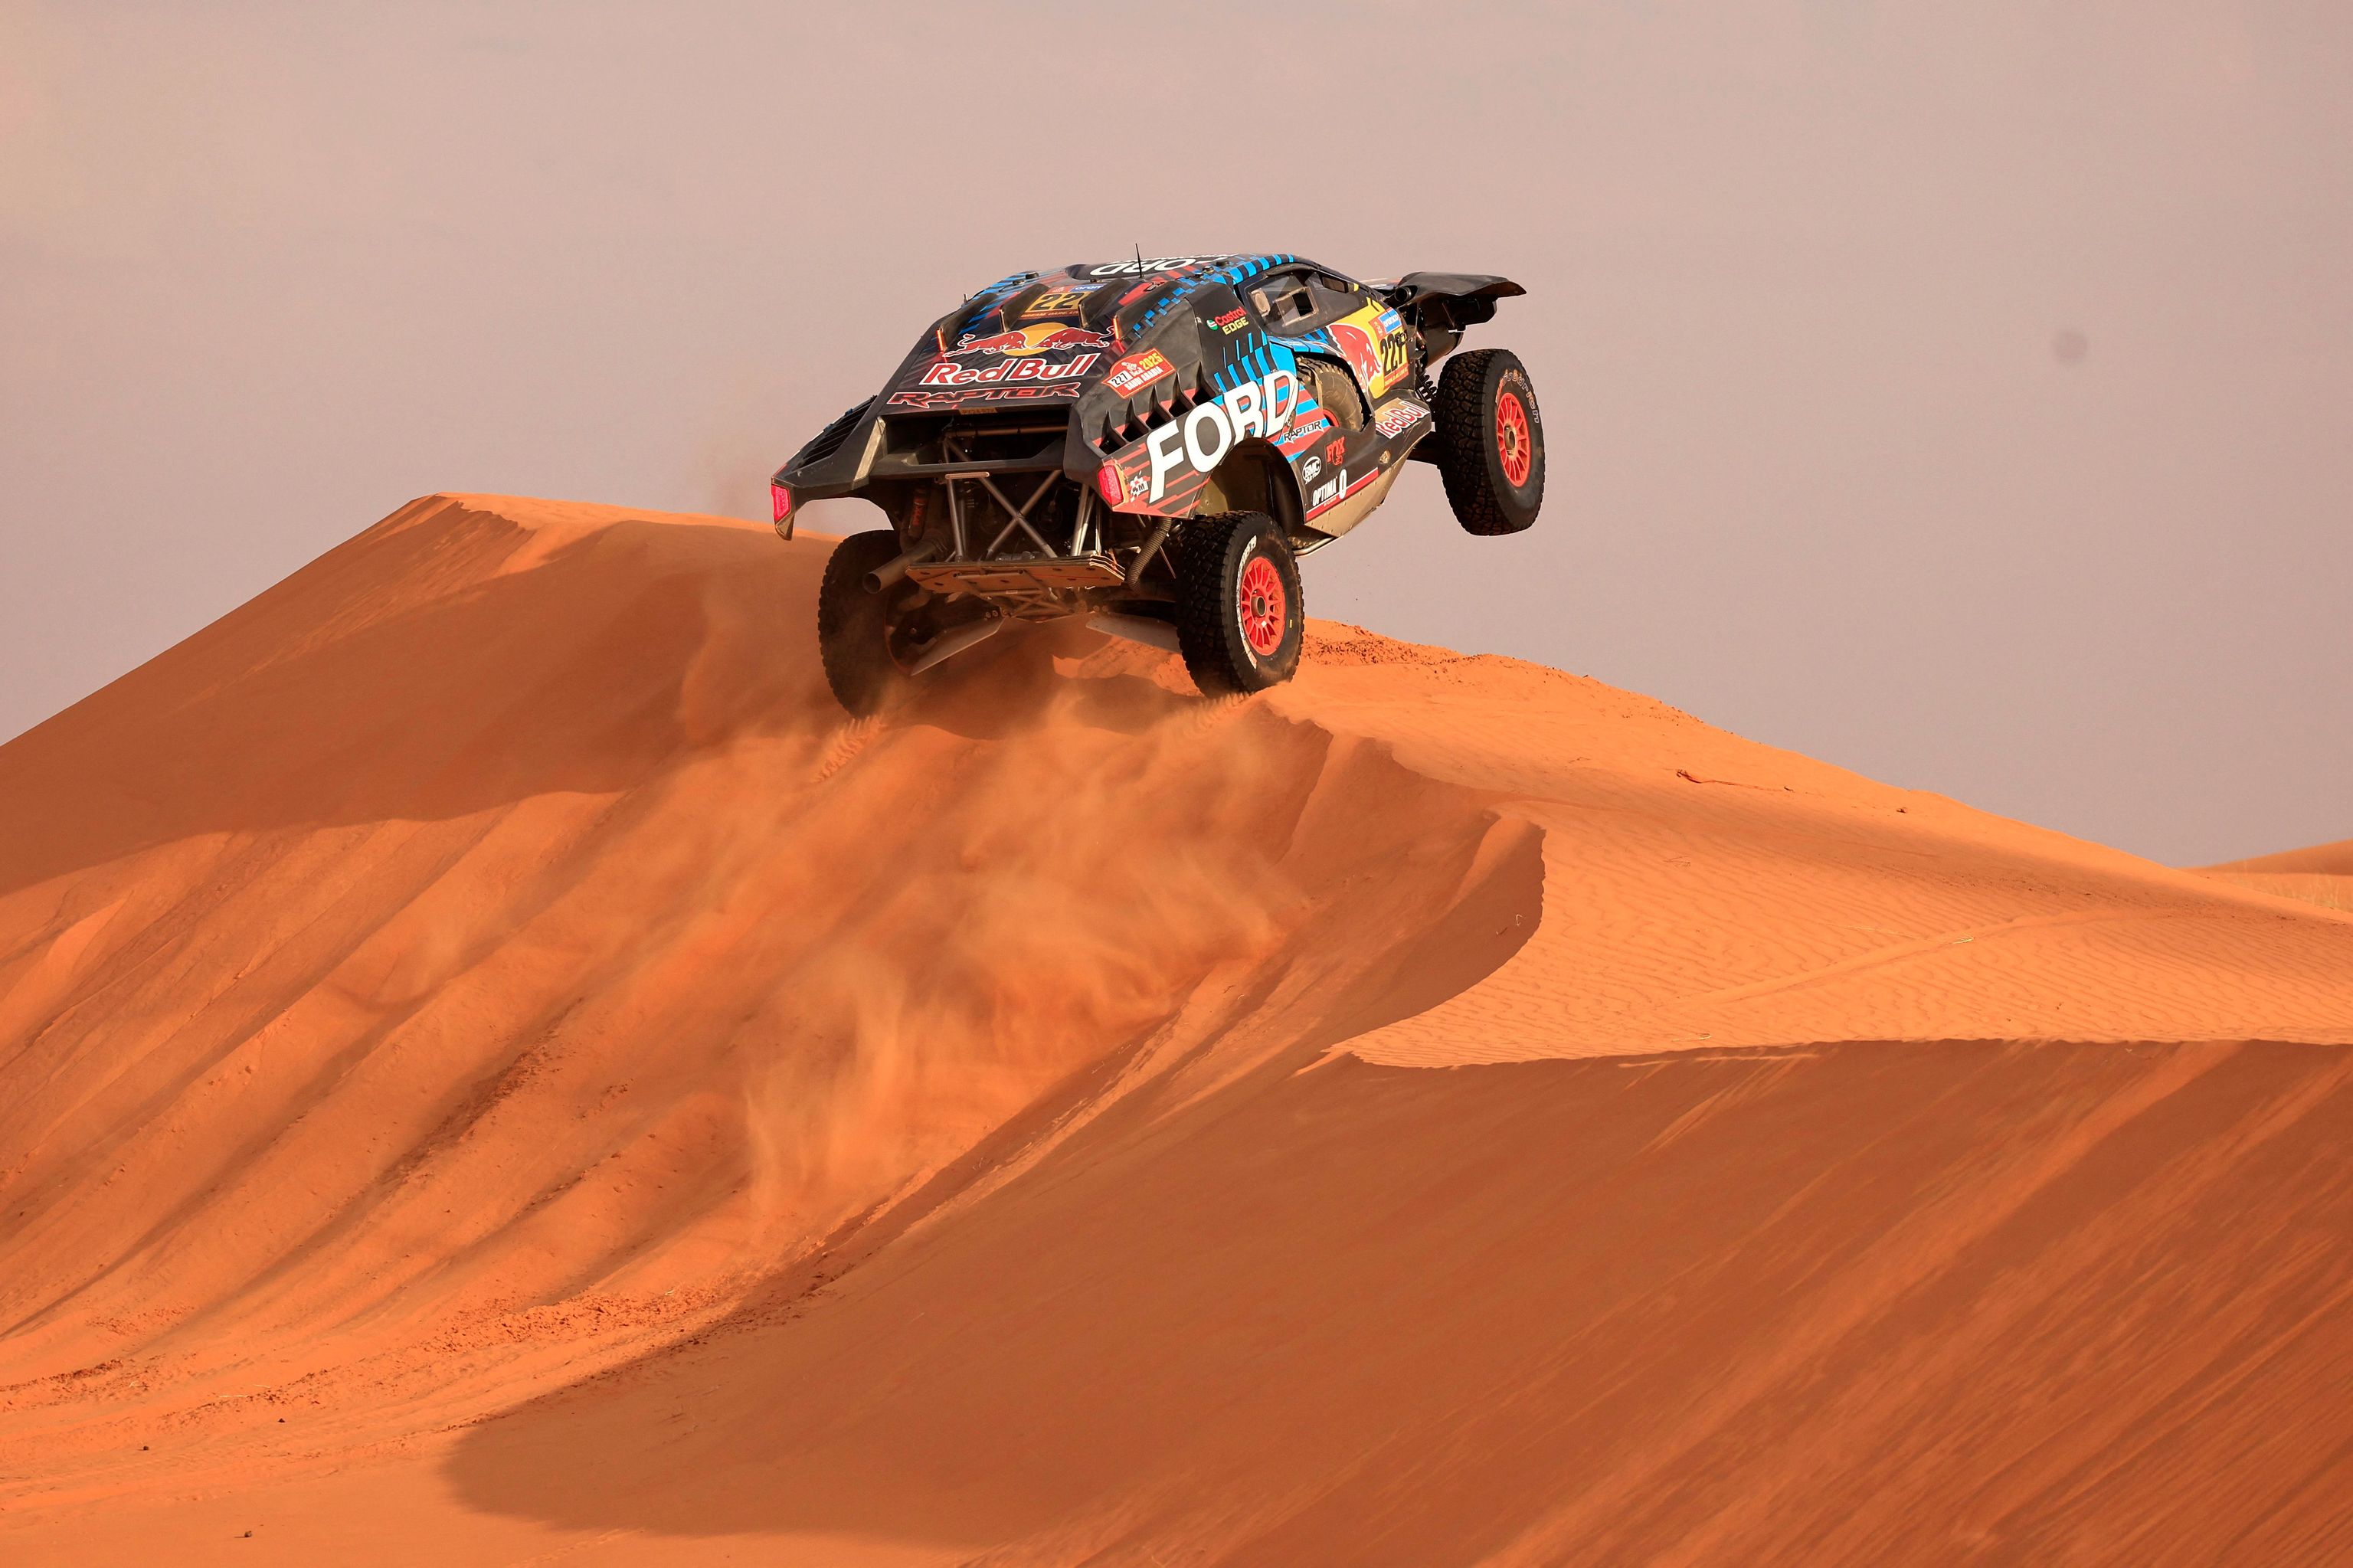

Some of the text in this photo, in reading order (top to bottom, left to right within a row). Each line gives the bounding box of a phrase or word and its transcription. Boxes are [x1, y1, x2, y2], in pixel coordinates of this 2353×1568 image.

[1215, 306, 1247, 326] Castrol
[1222, 316, 1249, 335] EDGE
[919, 353, 1101, 385] Red Bull
[1139, 352, 1163, 370] 2025
[1111, 372, 1128, 386] 227
[1124, 376, 1145, 390] SAUDI
[1141, 366, 1164, 381] ARABIA
[887, 382, 1081, 408] RAPTOR
[1388, 400, 1431, 424] Bull
[1146, 369, 1299, 504] FORD
[1284, 421, 1323, 442] RAPTOR
[1304, 459, 1320, 478] BMC
[1312, 477, 1337, 506] OPTIMA
